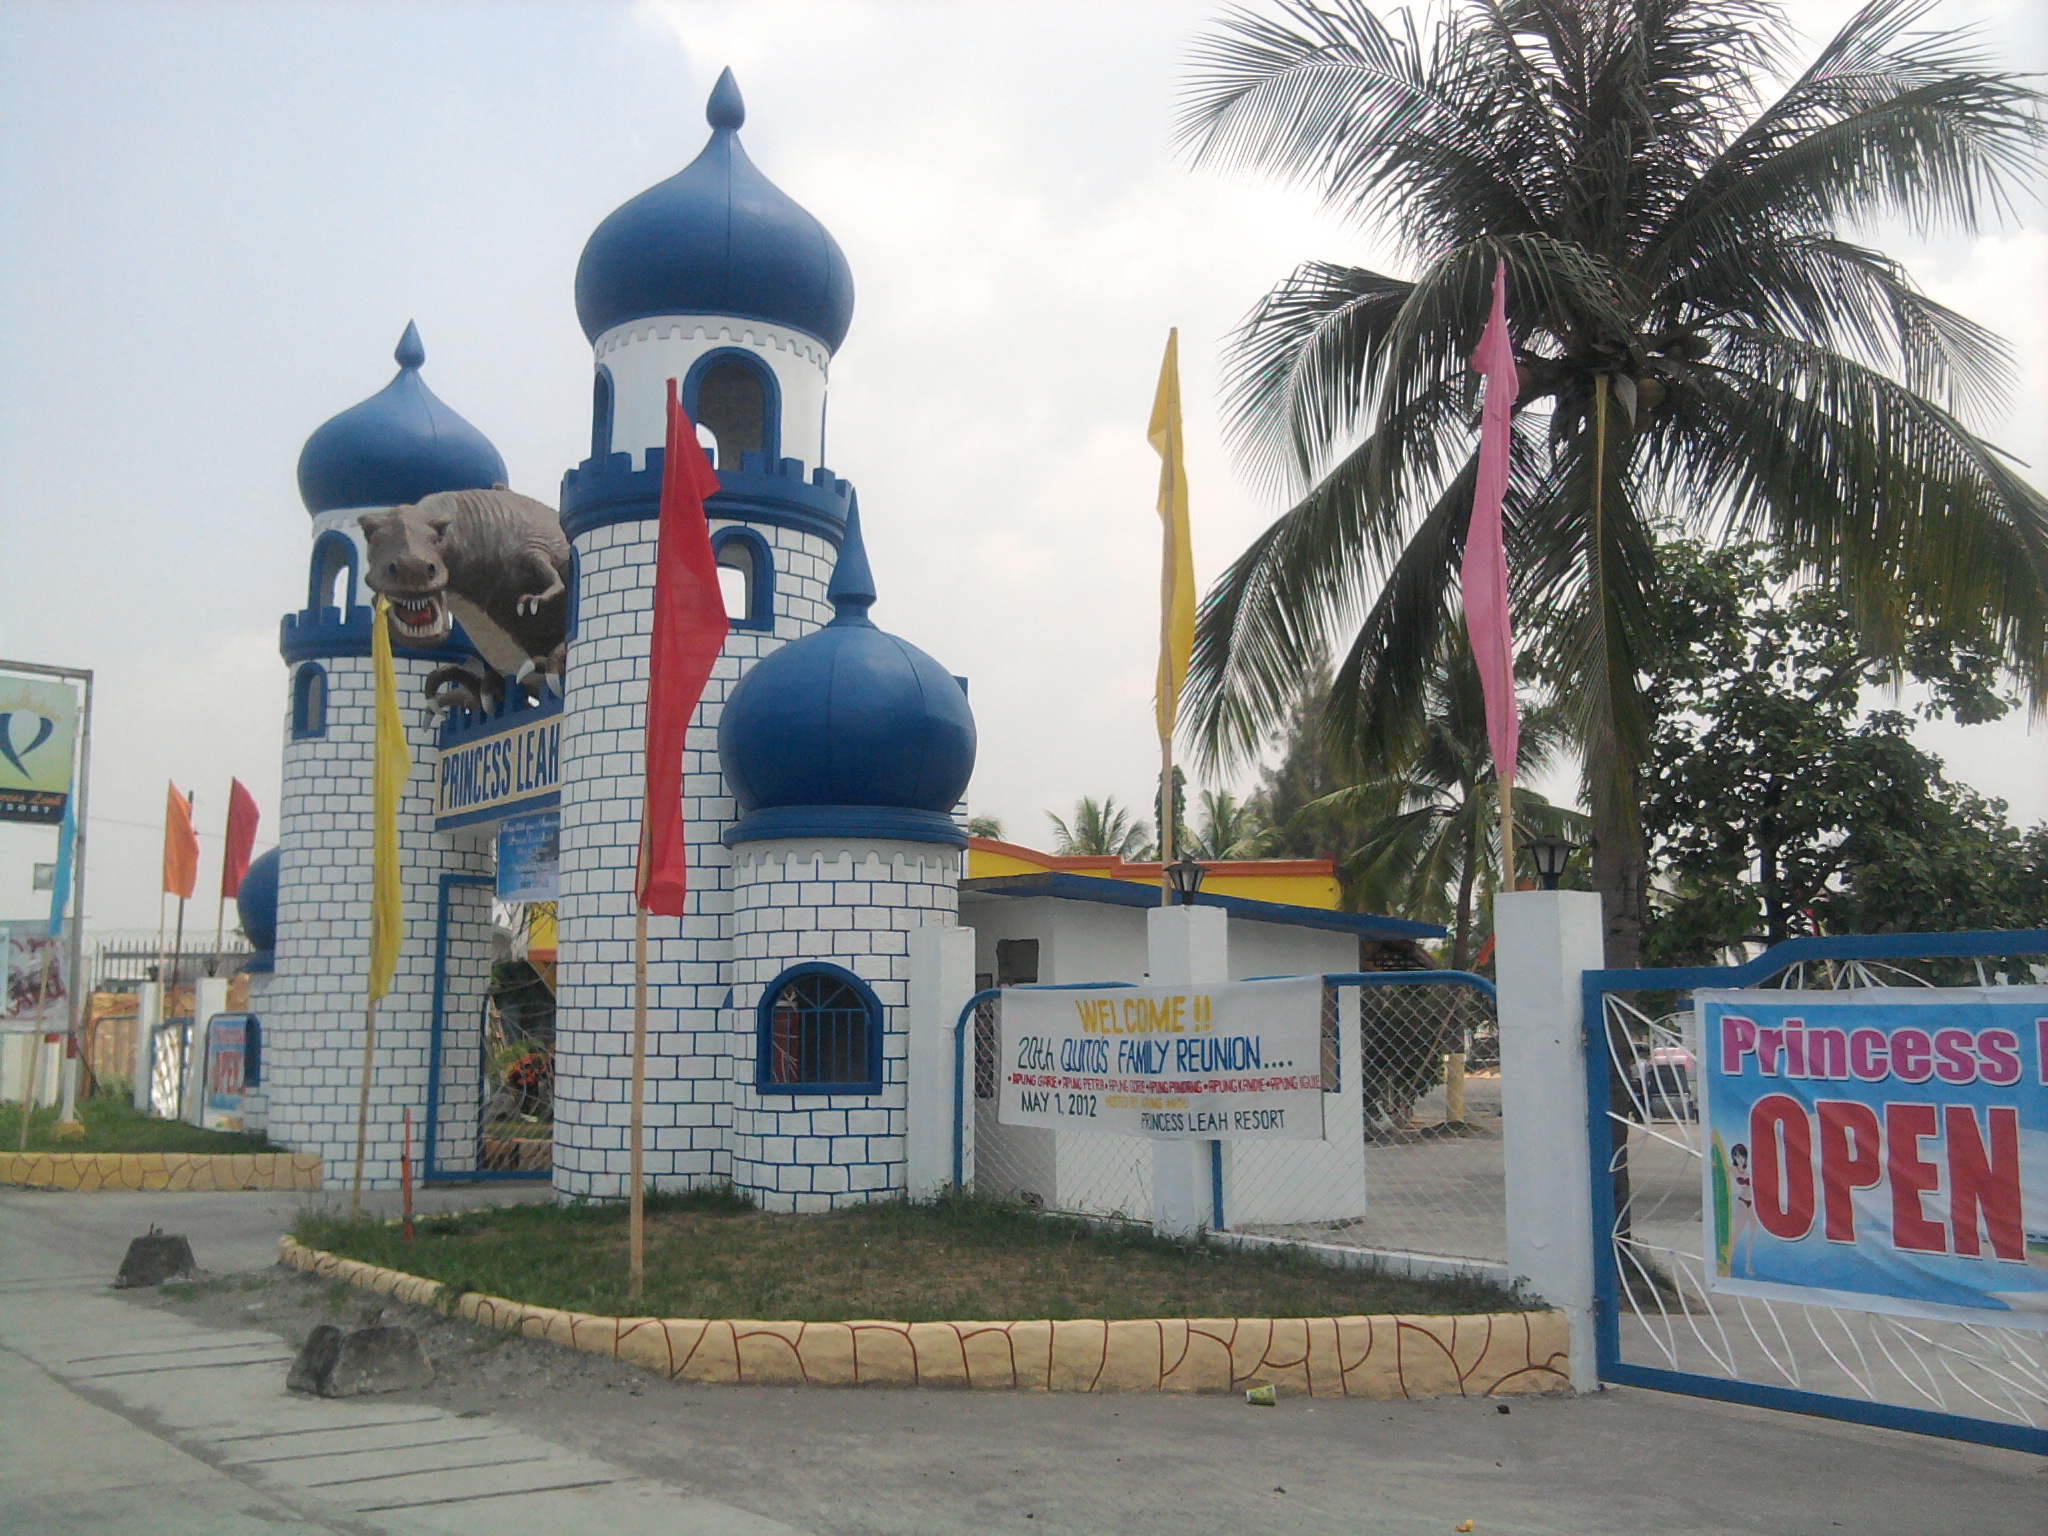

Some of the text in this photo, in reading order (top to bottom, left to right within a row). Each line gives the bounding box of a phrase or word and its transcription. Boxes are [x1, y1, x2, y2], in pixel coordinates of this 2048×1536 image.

[440, 722, 561, 811] PRINCESS LEAH
[0, 802, 50, 814] SORT
[1075, 994, 1211, 1034] WELCOME !!
[1017, 1036, 1055, 1072] 20th
[1060, 1035, 1109, 1074] QUITO'S
[1118, 1038, 1170, 1074] FAMILY
[1721, 1016, 2021, 1086] Princess
[1021, 1090, 1097, 1117] MAY 1, 2012
[1141, 1109, 1286, 1132] PRINCESS LEAH RESORT
[1750, 1093, 2026, 1264] OPEN
